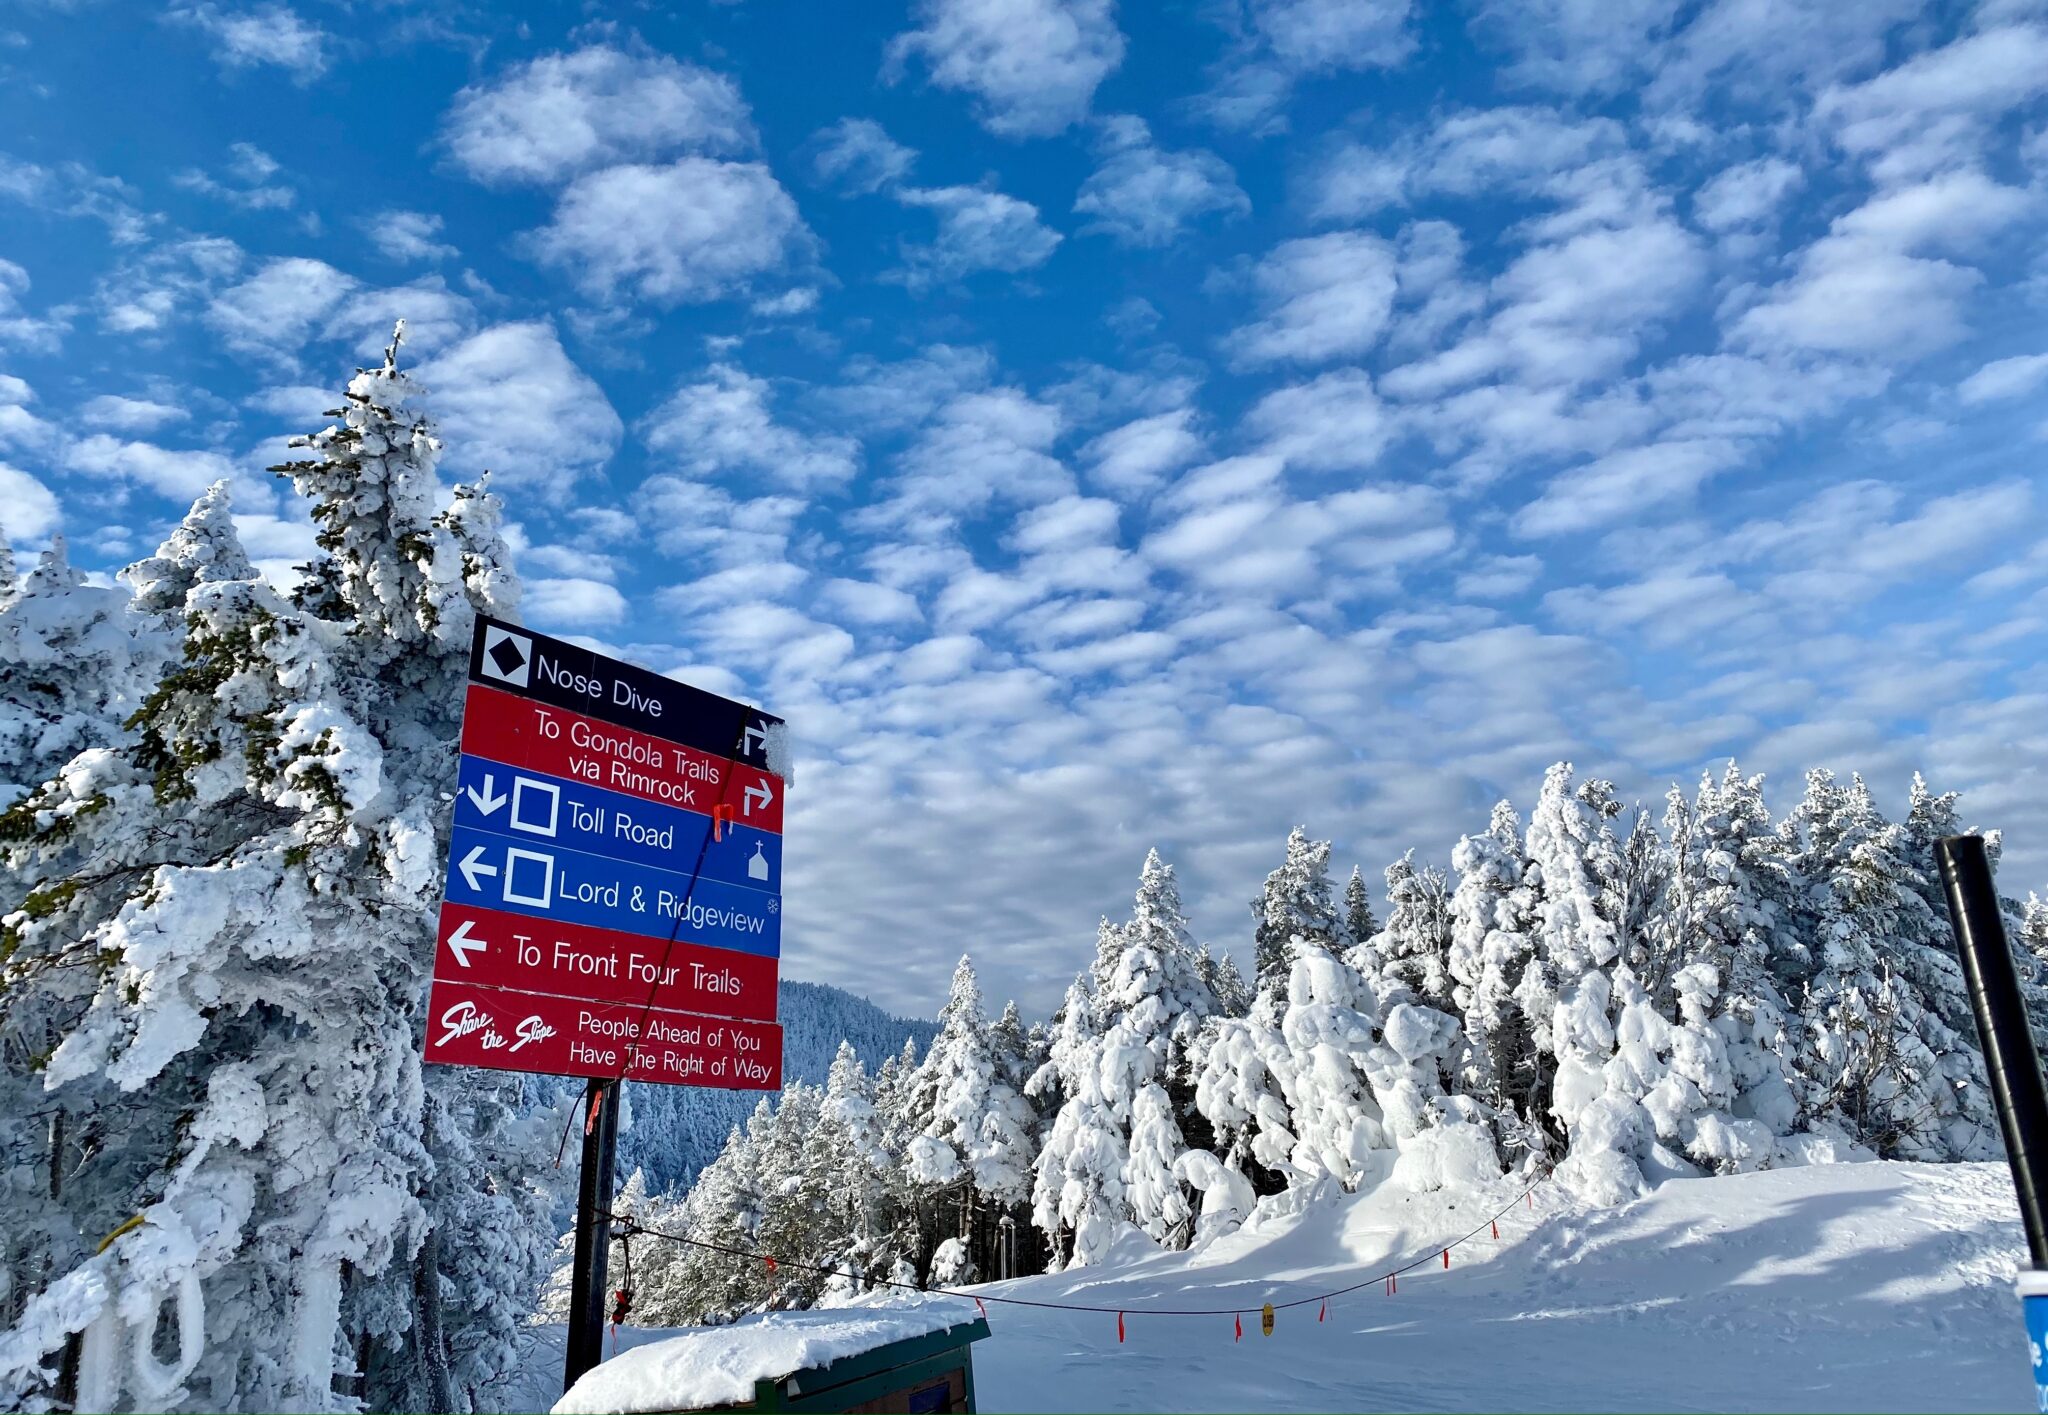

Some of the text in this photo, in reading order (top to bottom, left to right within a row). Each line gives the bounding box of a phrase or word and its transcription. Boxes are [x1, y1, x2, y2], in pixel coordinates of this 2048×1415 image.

[537, 655, 662, 717] Nose Dive
[535, 709, 719, 785] To Gondola Trails
[568, 756, 695, 804] via Rimrock
[567, 801, 673, 850] Toll Road
[559, 871, 765, 935] Lord & Ridgeview
[513, 934, 741, 995] To Front Four Trails
[435, 1001, 557, 1052] Share the Slope
[579, 1011, 760, 1051] People Ahead of You
[570, 1042, 772, 1083] Have The Right of Way
